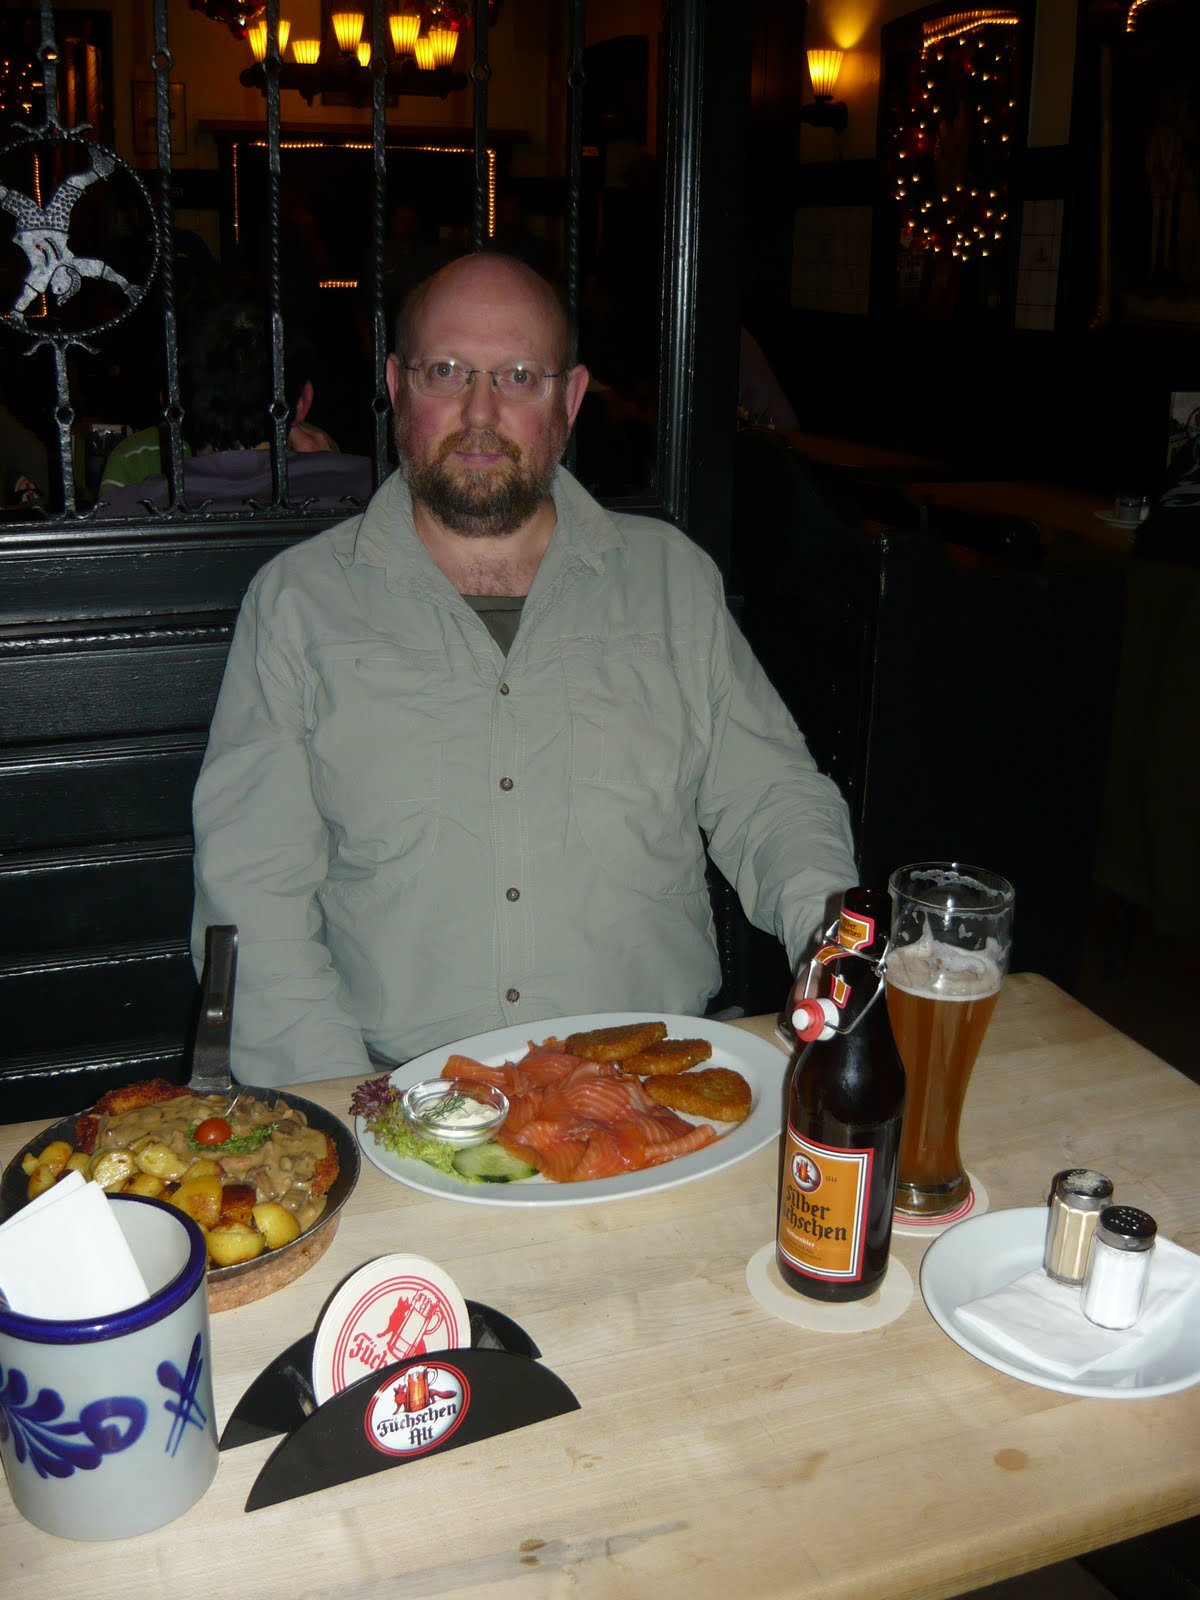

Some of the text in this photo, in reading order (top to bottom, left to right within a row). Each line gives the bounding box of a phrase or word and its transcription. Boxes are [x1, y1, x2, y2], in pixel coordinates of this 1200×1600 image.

[785, 1184, 831, 1220] Silber
[783, 1203, 847, 1241] chschen
[376, 1402, 457, 1438] Füchschen
[408, 1425, 434, 1446] Alt
